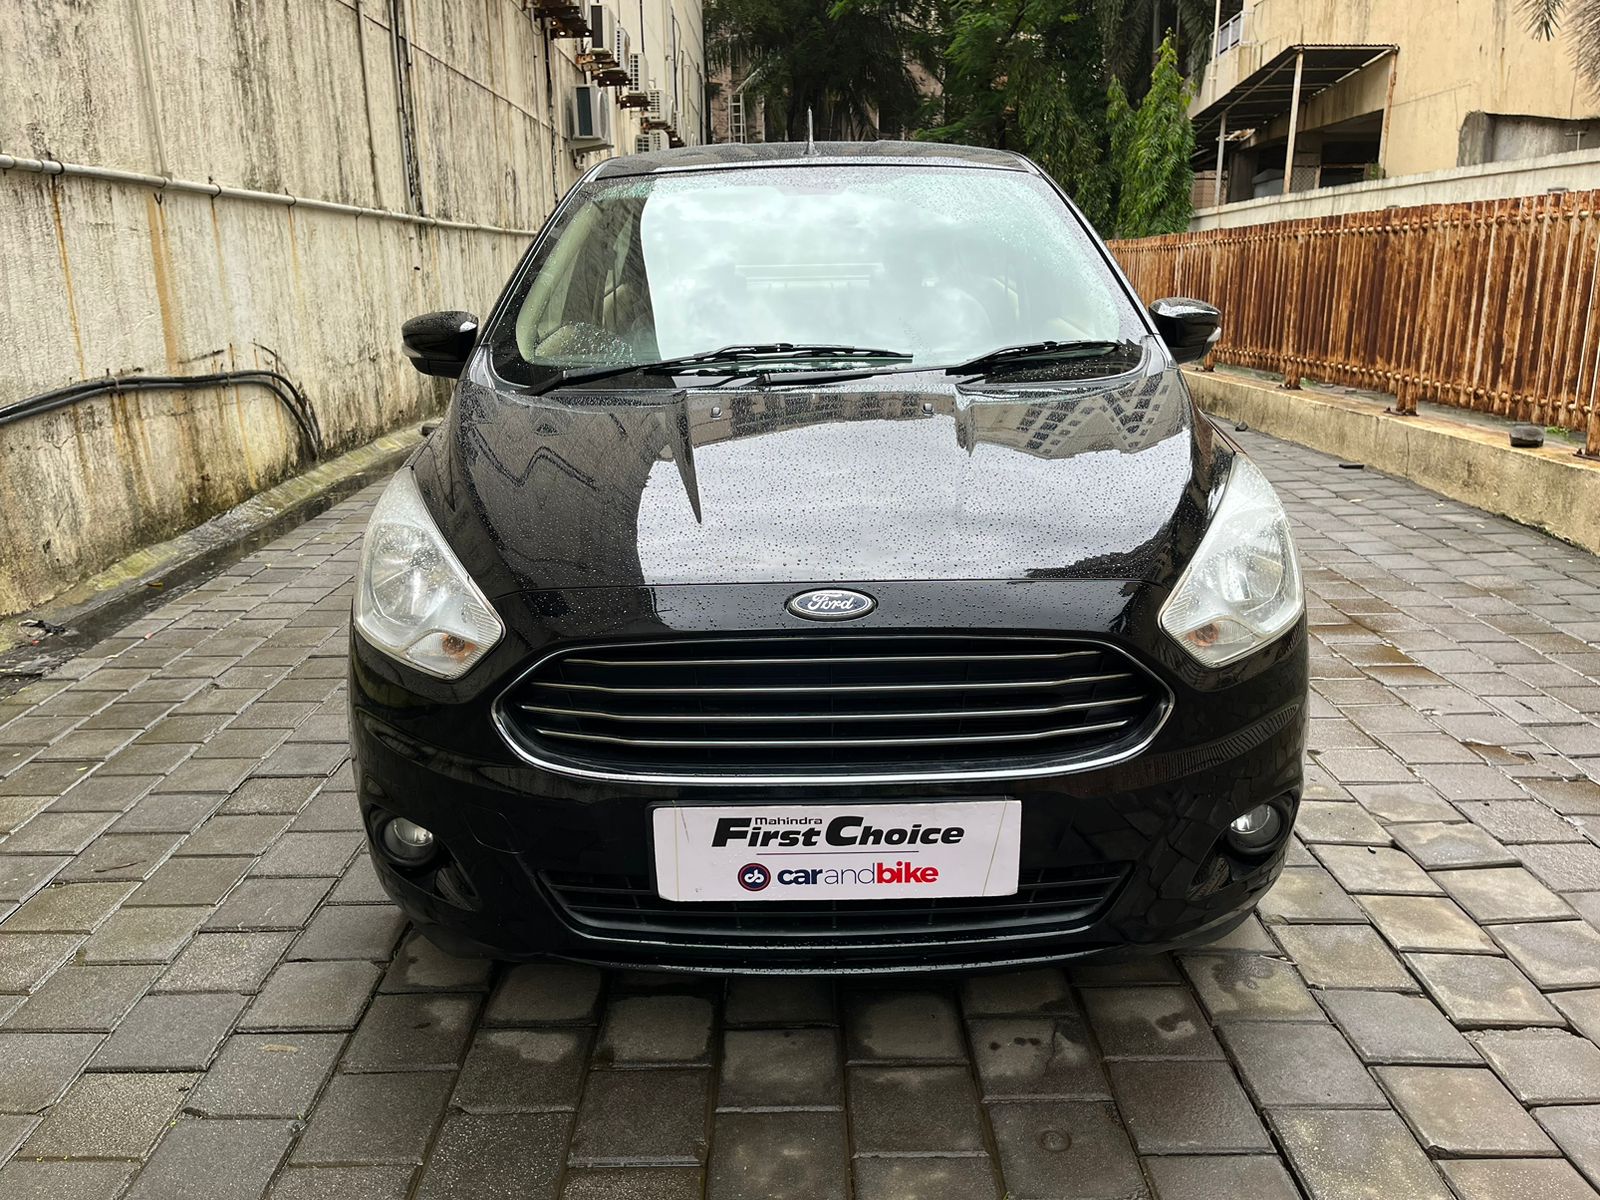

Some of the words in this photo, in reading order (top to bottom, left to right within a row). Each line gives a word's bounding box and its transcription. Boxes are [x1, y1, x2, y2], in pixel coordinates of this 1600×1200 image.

[807, 593, 854, 610] Ford
[755, 816, 823, 826] Mahindra
[711, 818, 822, 847] First
[825, 816, 964, 846] Choice
[777, 861, 939, 885] carandbike
